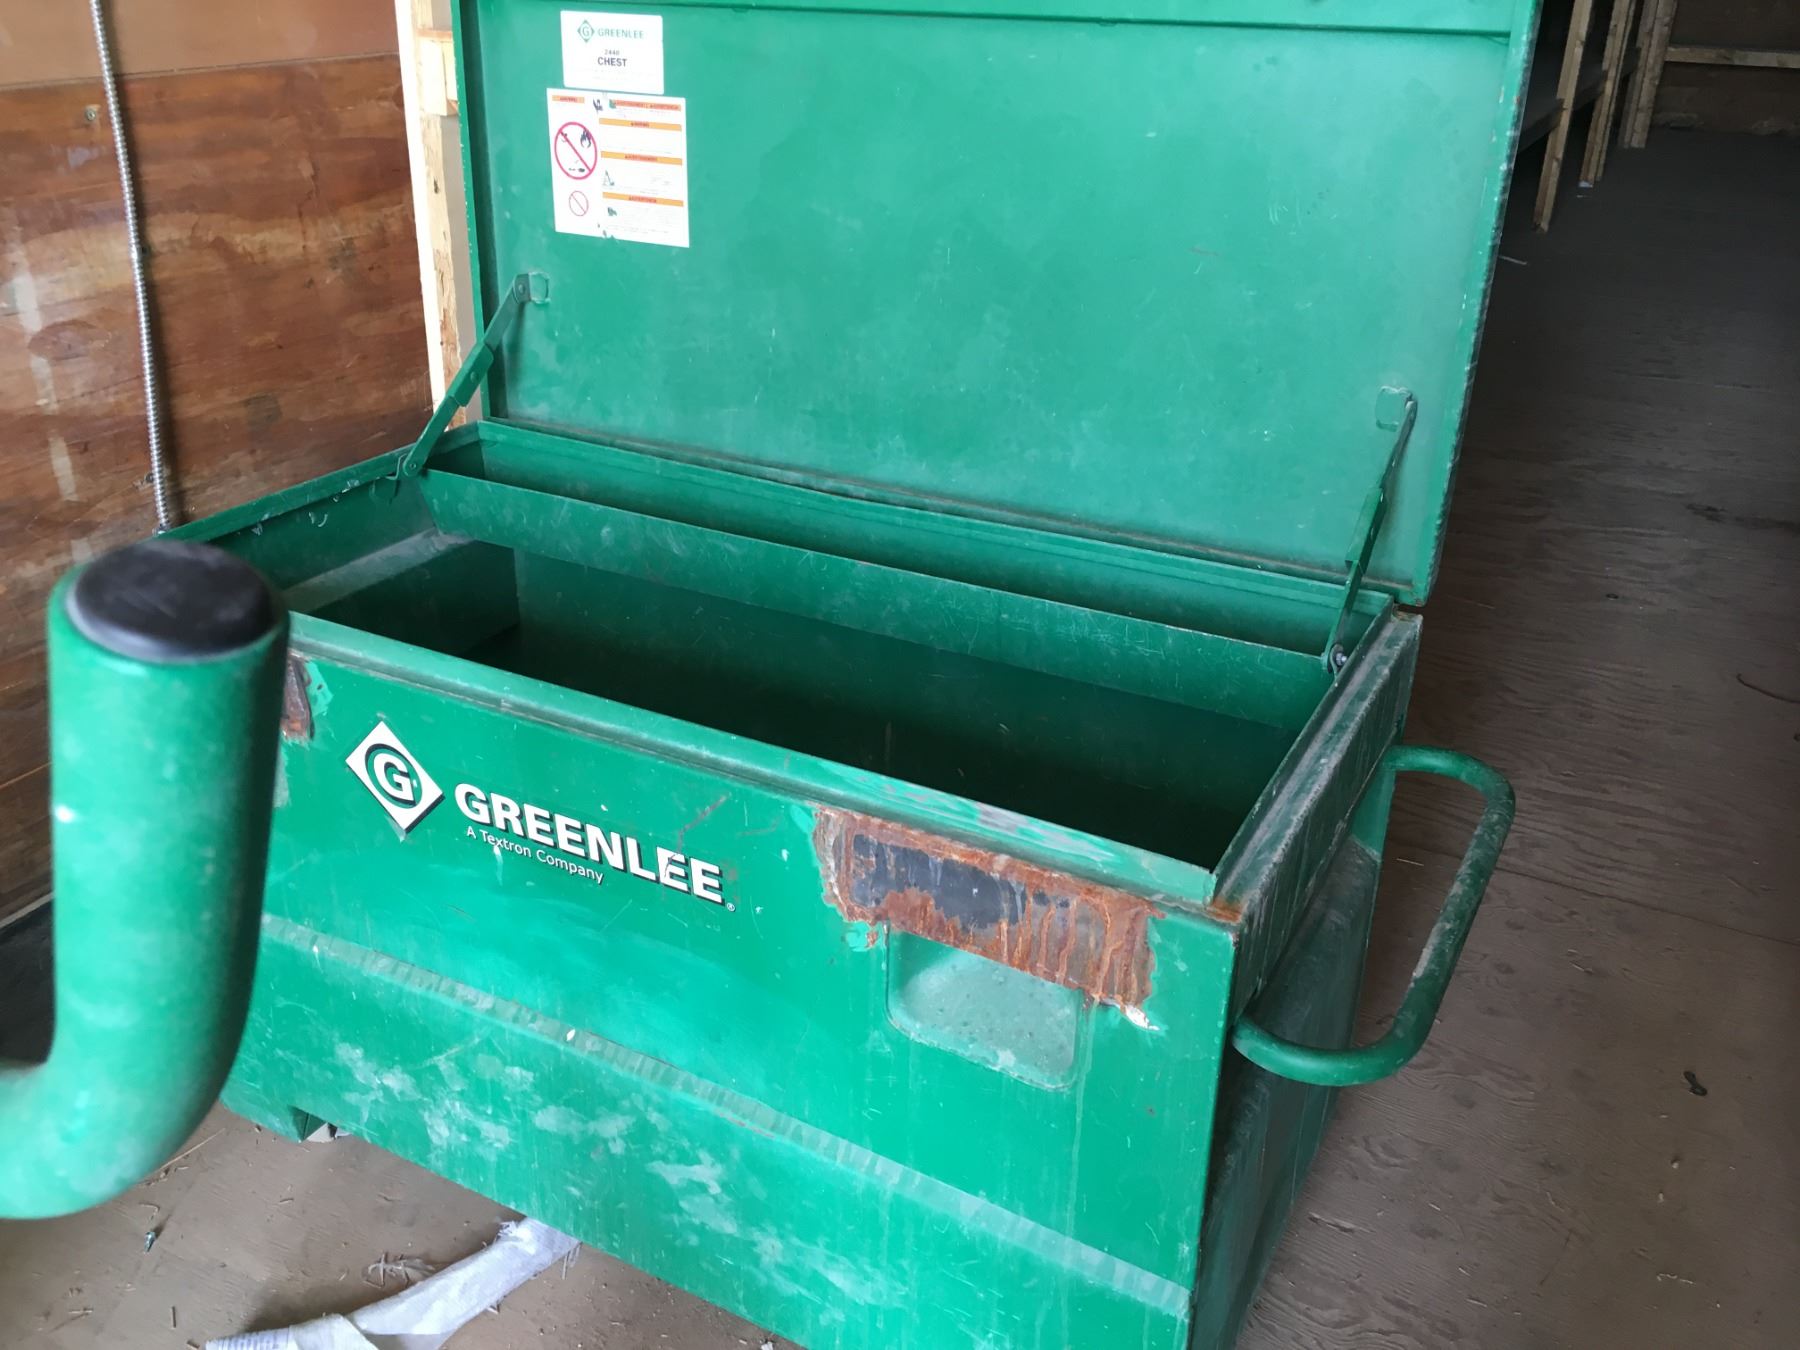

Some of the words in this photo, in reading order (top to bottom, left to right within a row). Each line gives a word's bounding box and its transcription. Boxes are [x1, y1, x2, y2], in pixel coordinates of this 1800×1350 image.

[598, 27, 644, 39] GREENLEE
[597, 56, 628, 67] CHEST
[454, 783, 724, 904] GREENLEE
[466, 825, 477, 839] A
[480, 829, 532, 859] Textron
[536, 849, 604, 885] Company
